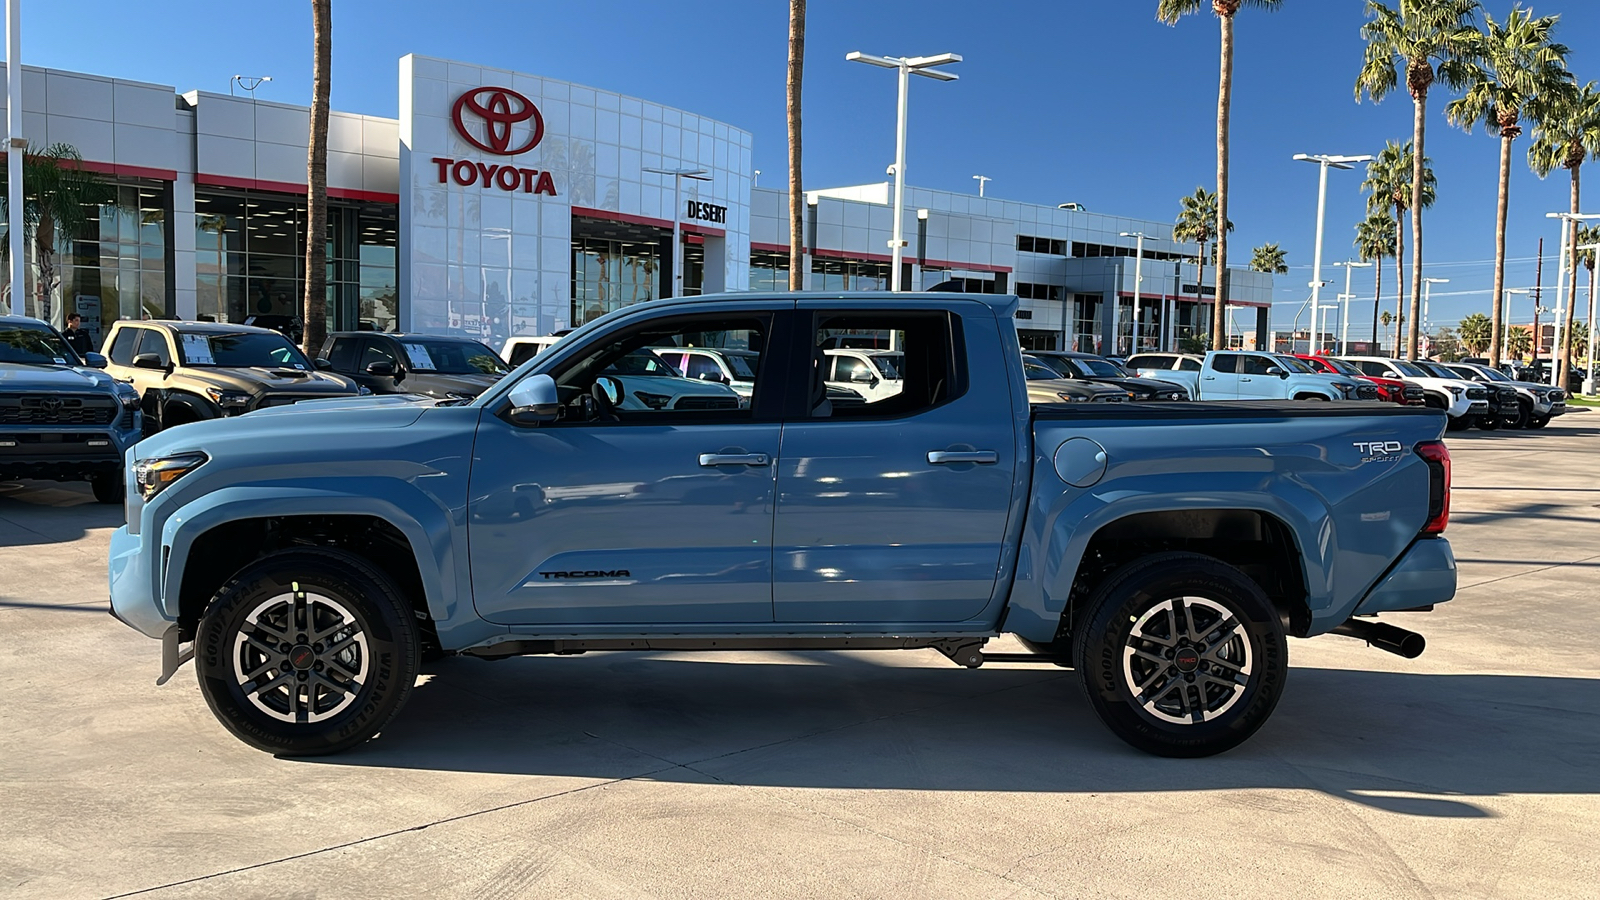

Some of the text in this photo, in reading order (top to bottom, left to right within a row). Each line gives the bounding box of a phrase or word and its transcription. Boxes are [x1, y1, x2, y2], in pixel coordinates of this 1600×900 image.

[432, 157, 557, 196] TOYOTA
[688, 200, 728, 224] DESERT
[1353, 441, 1402, 456] TRD
[539, 570, 630, 579] TACOMA
[206, 580, 263, 667] GOODYEAR
[1103, 598, 1139, 692] GOODYEAR
[338, 651, 392, 740] WRANGLER
[1243, 631, 1278, 725] WRANGLER
